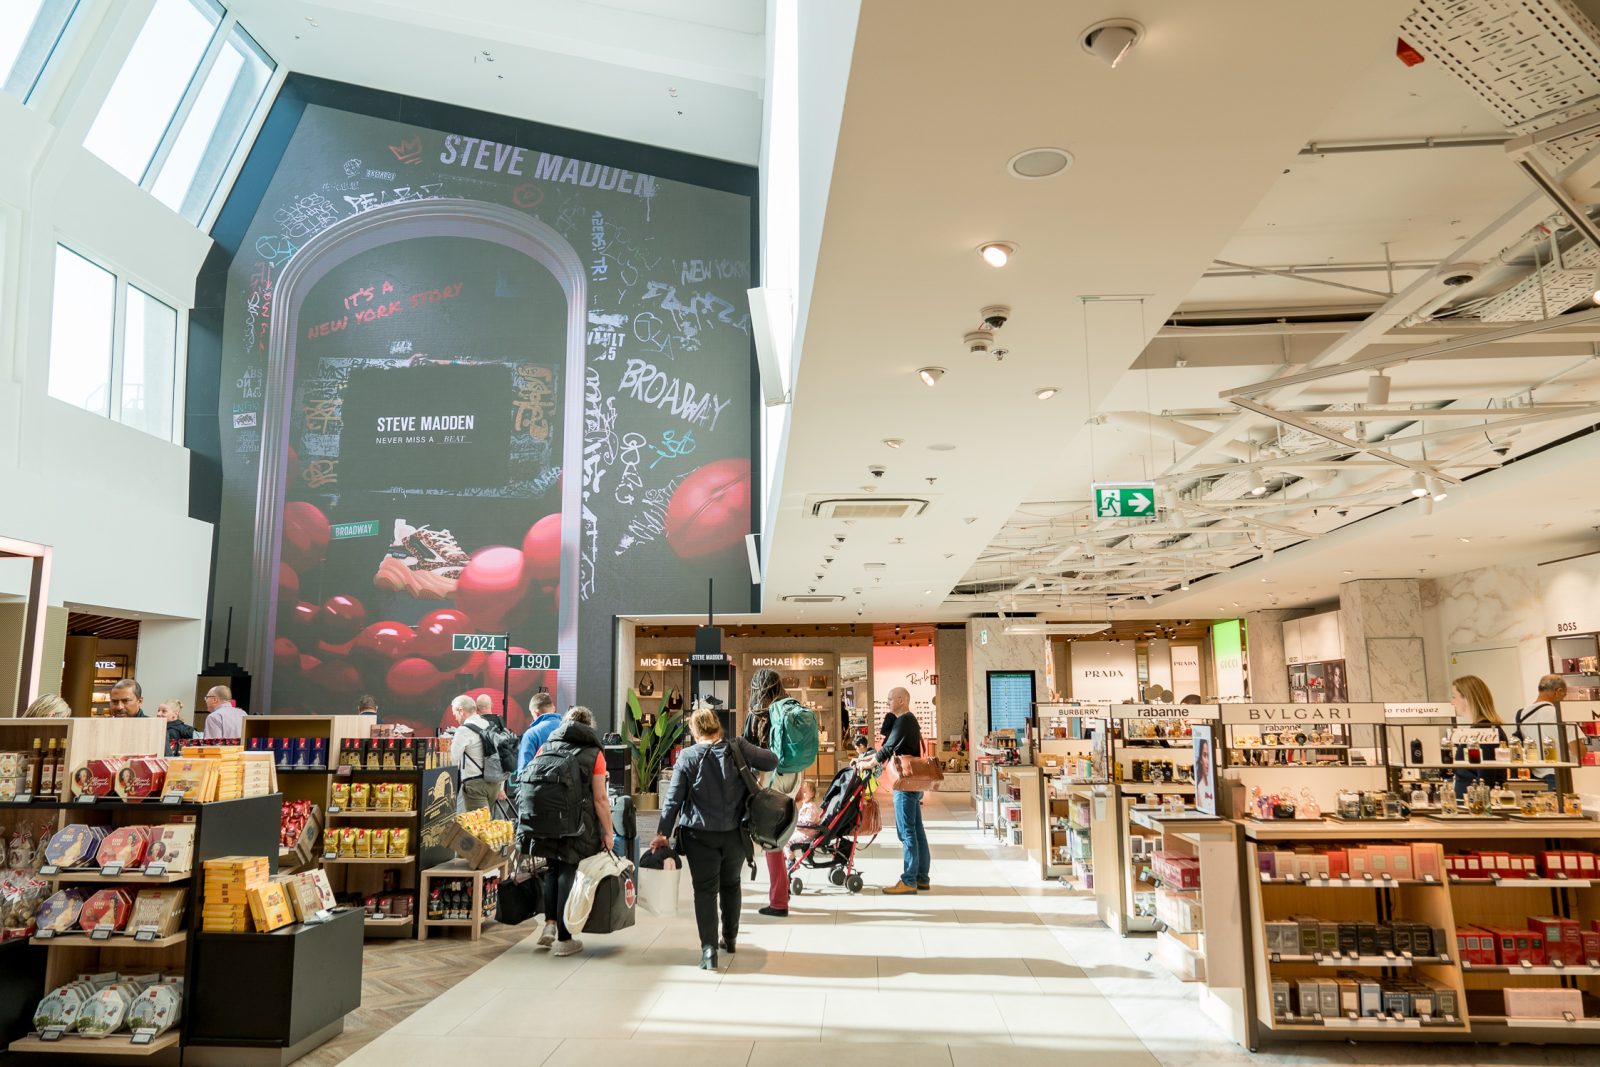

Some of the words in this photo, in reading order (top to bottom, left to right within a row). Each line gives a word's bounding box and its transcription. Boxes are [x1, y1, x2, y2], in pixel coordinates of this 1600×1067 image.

[440, 133, 529, 176] STEVE
[534, 153, 657, 198] MADDEN
[681, 259, 712, 285] NEW
[716, 259, 750, 279] YORK
[344, 284, 375, 310] IT'S
[382, 281, 394, 294] A
[308, 316, 348, 340] NEW
[355, 301, 404, 326] YORK
[410, 283, 464, 309] STORY
[618, 358, 732, 432] BROADWAY
[377, 416, 416, 432] STEVE
[420, 415, 475, 431] MADDEN
[376, 436, 403, 444] NEVER
[405, 436, 427, 444] MISS
[443, 435, 466, 444] BEAT
[335, 523, 373, 537] BROADWAY
[1557, 621, 1578, 632] BOSS
[463, 635, 496, 651] 2024
[519, 654, 551, 669] 1990
[640, 658, 683, 667] MICHAEL
[752, 657, 795, 666] MICHAEL
[799, 657, 825, 666] KORS
[1084, 669, 1124, 678] PRADA
[1058, 708, 1100, 716] BURBERRY
[1137, 706, 1189, 718] rabanne
[1249, 708, 1352, 719] BVLGARI
